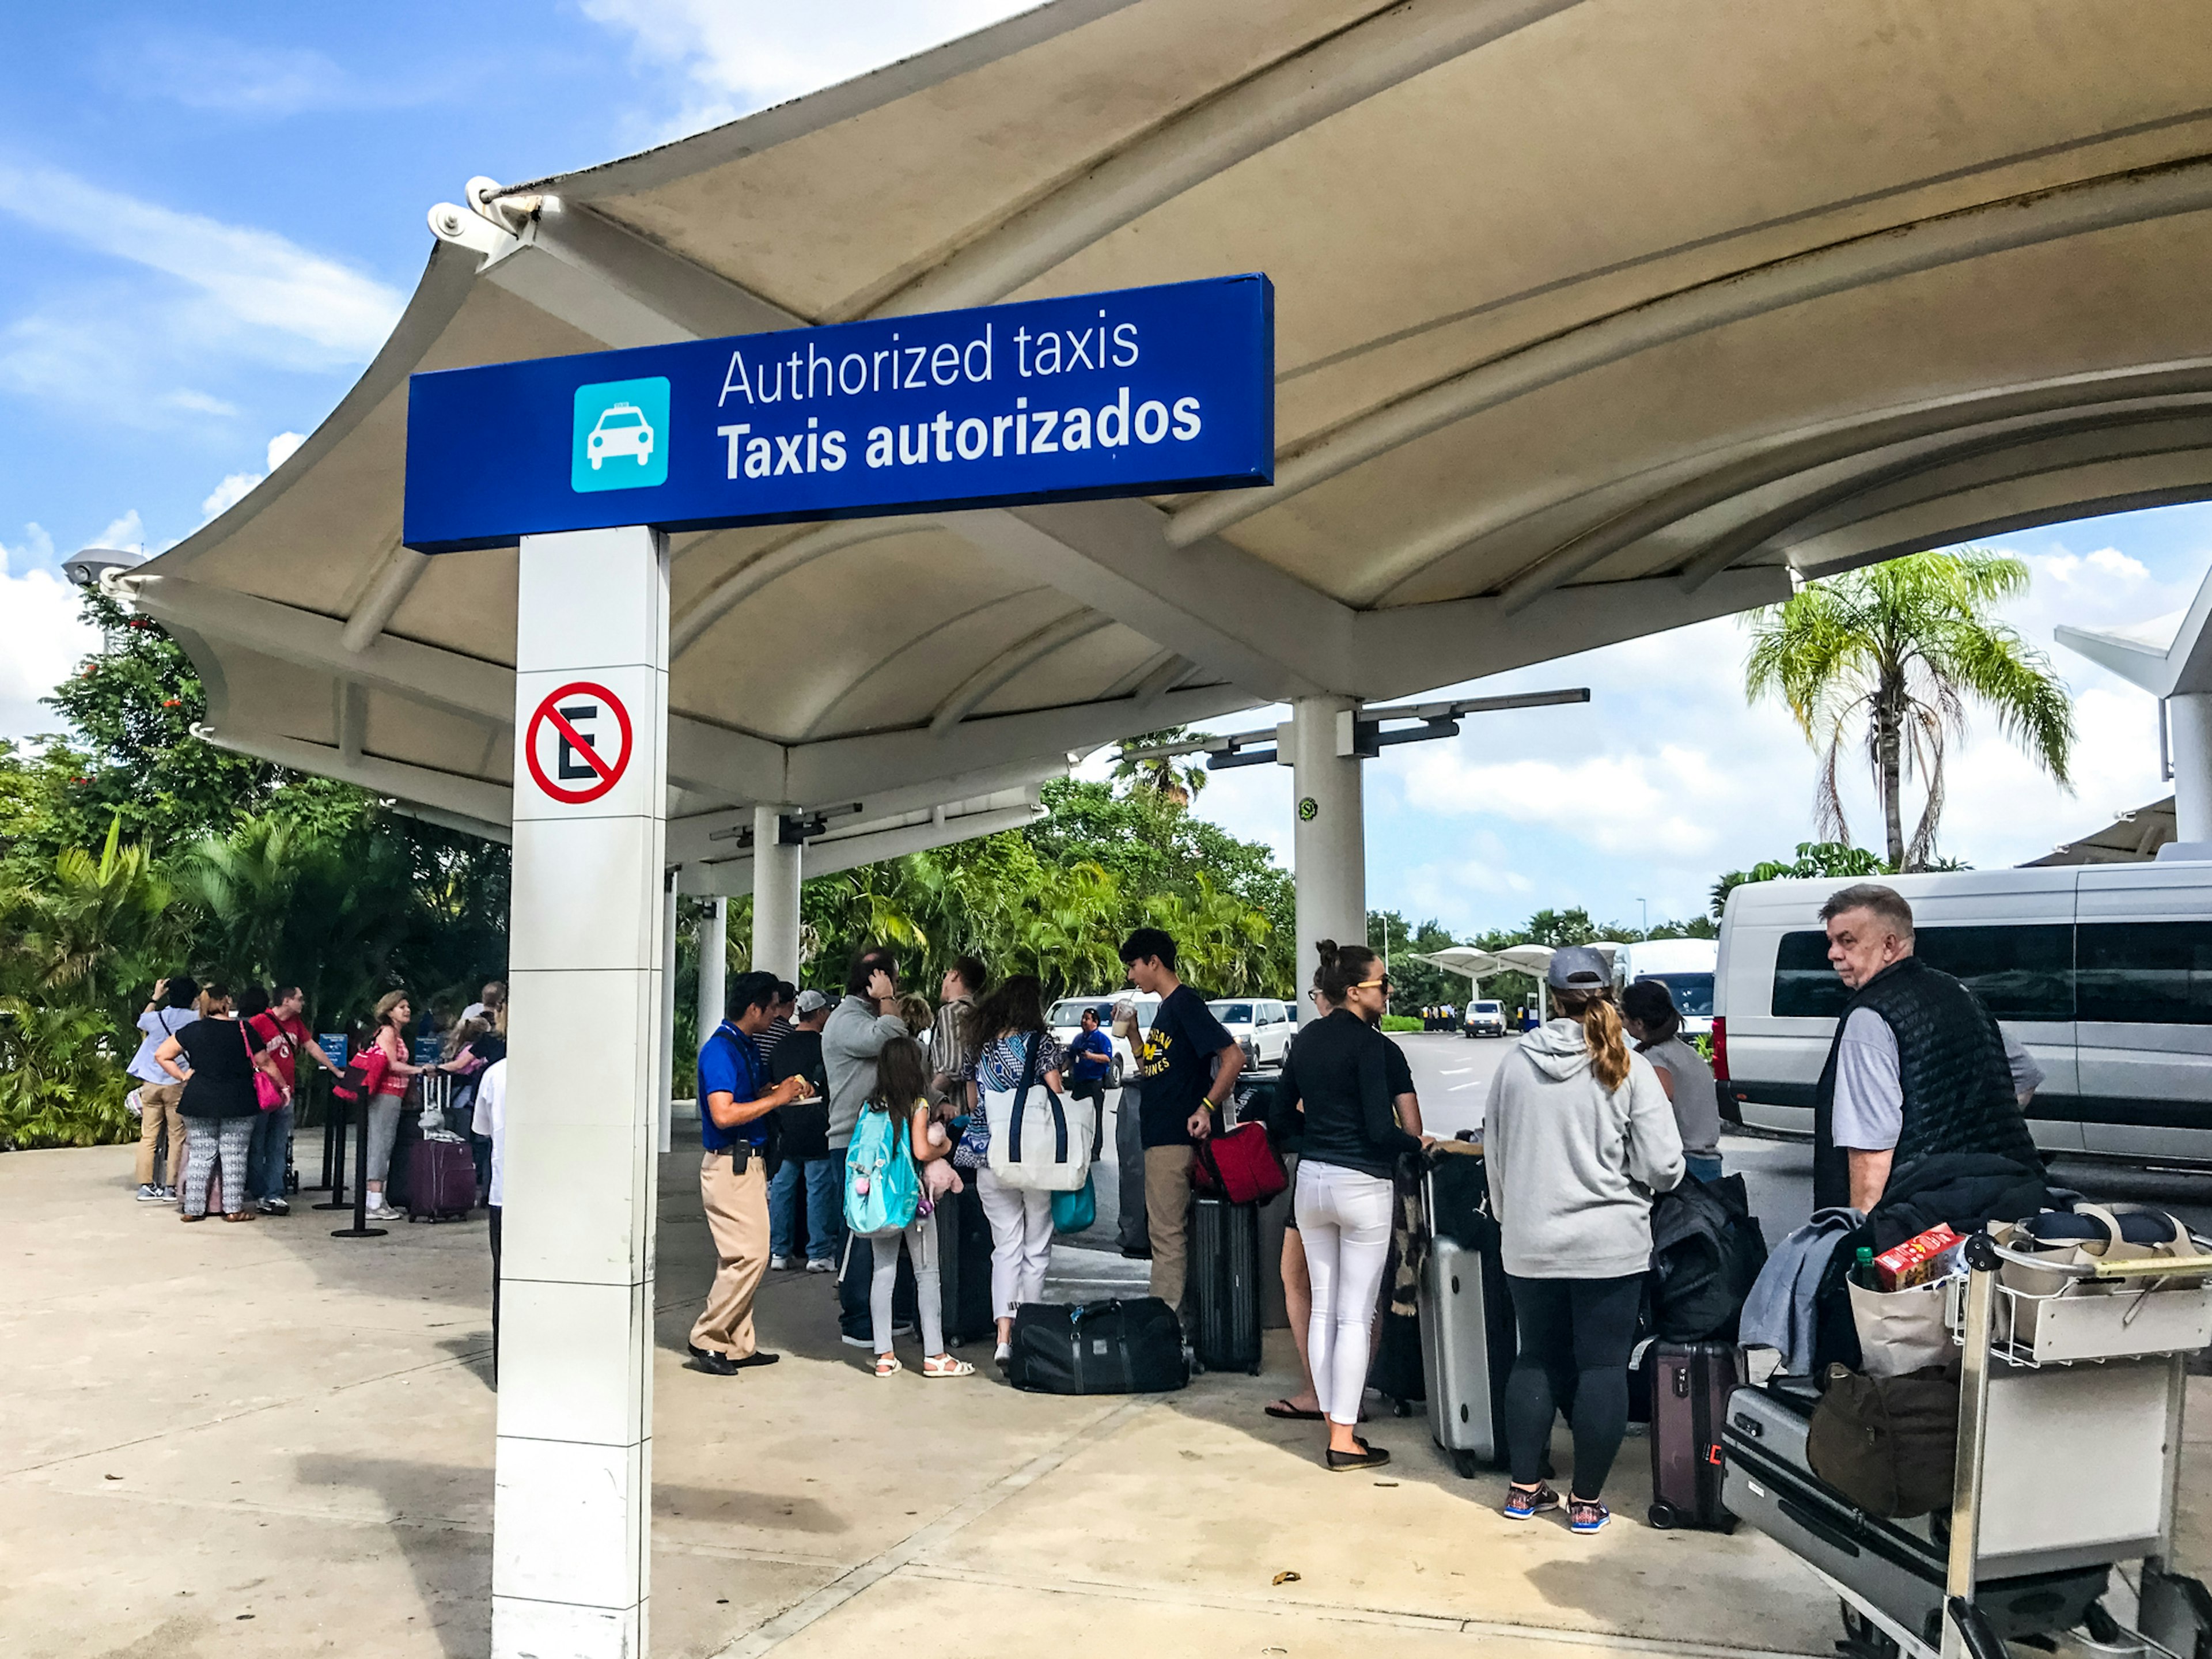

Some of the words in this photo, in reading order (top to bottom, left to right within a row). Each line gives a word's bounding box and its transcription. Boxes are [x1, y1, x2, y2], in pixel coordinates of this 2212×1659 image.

[718, 323, 991, 407] Authorized
[1014, 310, 1138, 377] taxis
[718, 417, 846, 479] Taxis
[866, 387, 1200, 468] autorizados
[559, 706, 598, 779] E
